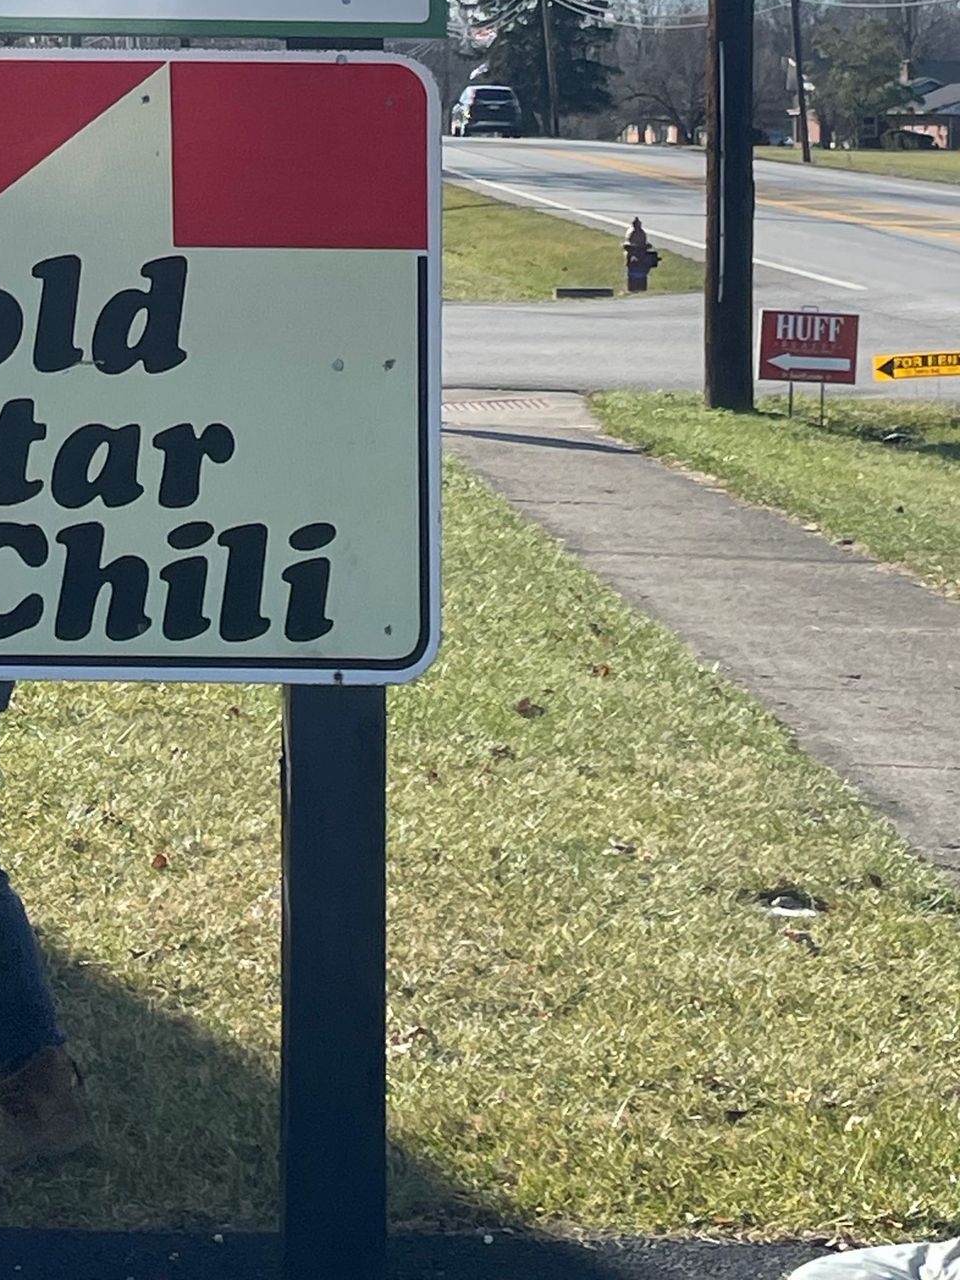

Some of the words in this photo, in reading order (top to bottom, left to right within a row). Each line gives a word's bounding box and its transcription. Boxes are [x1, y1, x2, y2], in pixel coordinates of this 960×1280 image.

[776, 314, 844, 343] HUFF
[893, 356, 923, 369] FOR
[926, 353, 960, 368] EN
